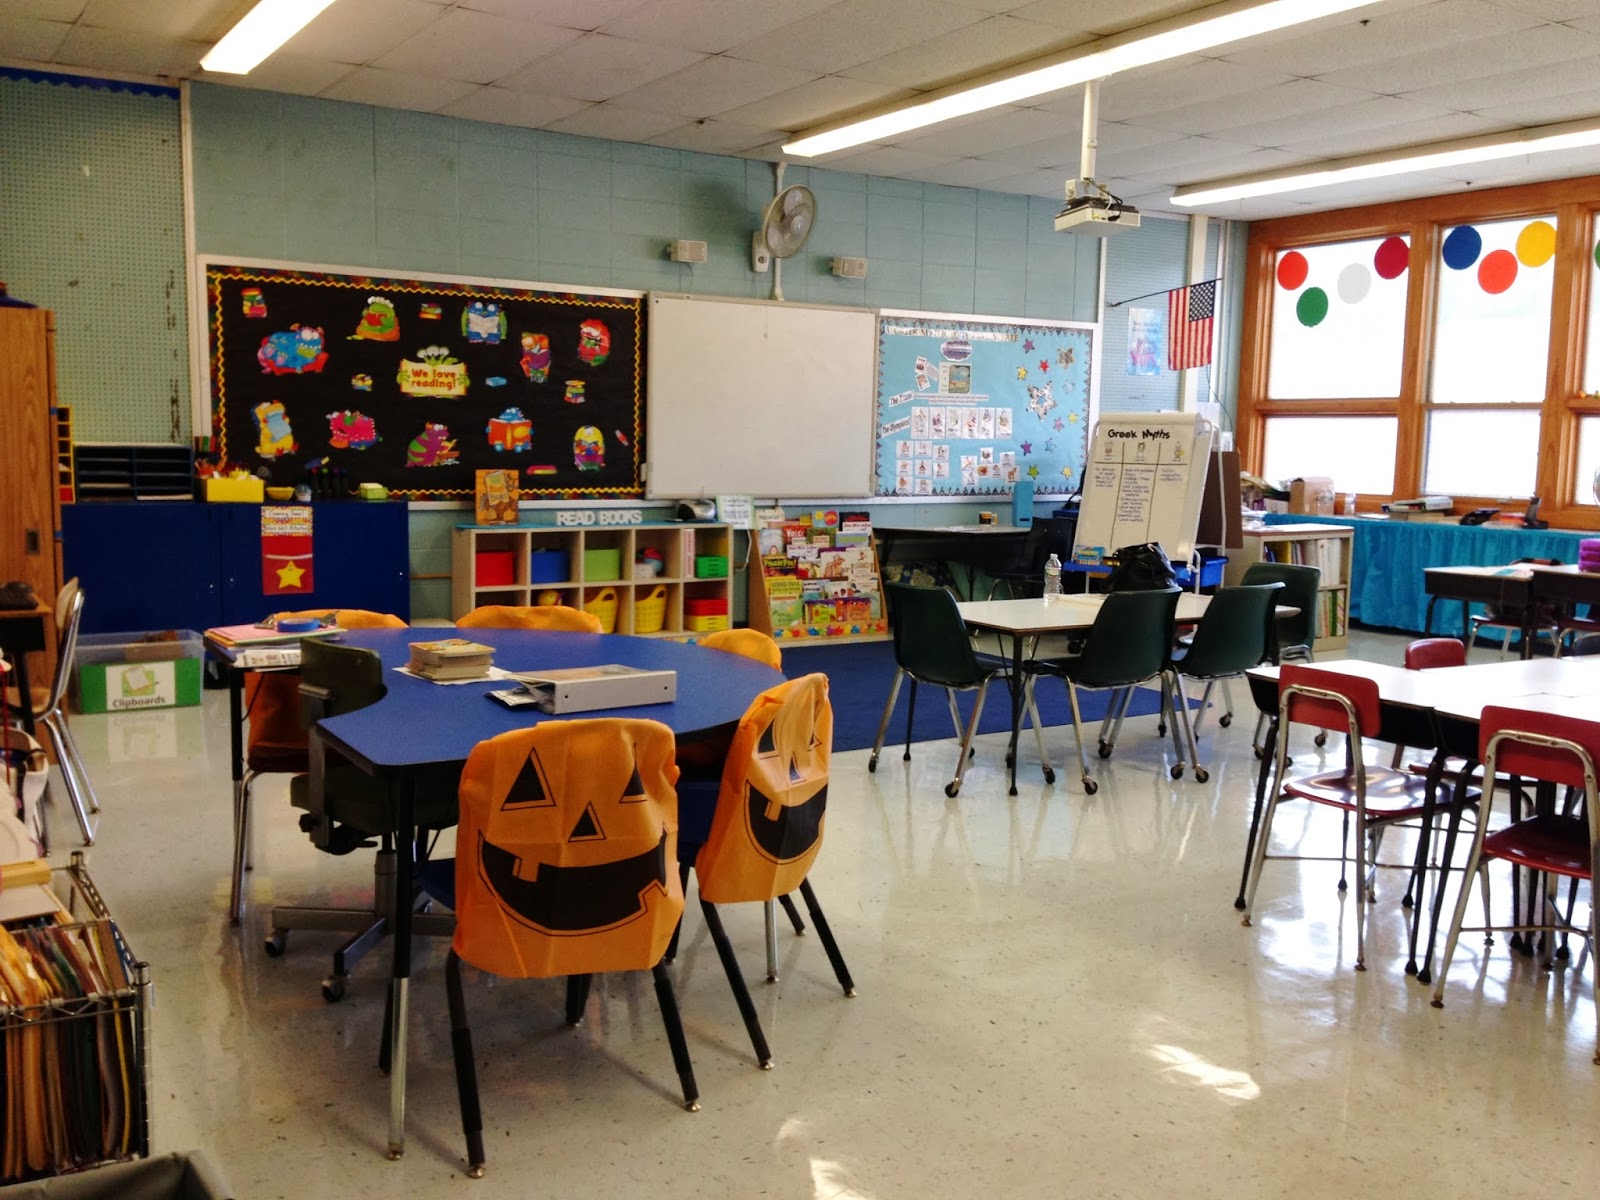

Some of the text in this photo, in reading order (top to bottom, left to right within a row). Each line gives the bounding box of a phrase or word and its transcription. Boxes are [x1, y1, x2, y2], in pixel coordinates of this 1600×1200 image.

[411, 368, 456, 379] We love
[411, 378, 456, 391] reading!
[1107, 428, 1170, 441] Greek Myths
[556, 509, 643, 526] READ BOOKS
[112, 696, 166, 709] Clipboards
